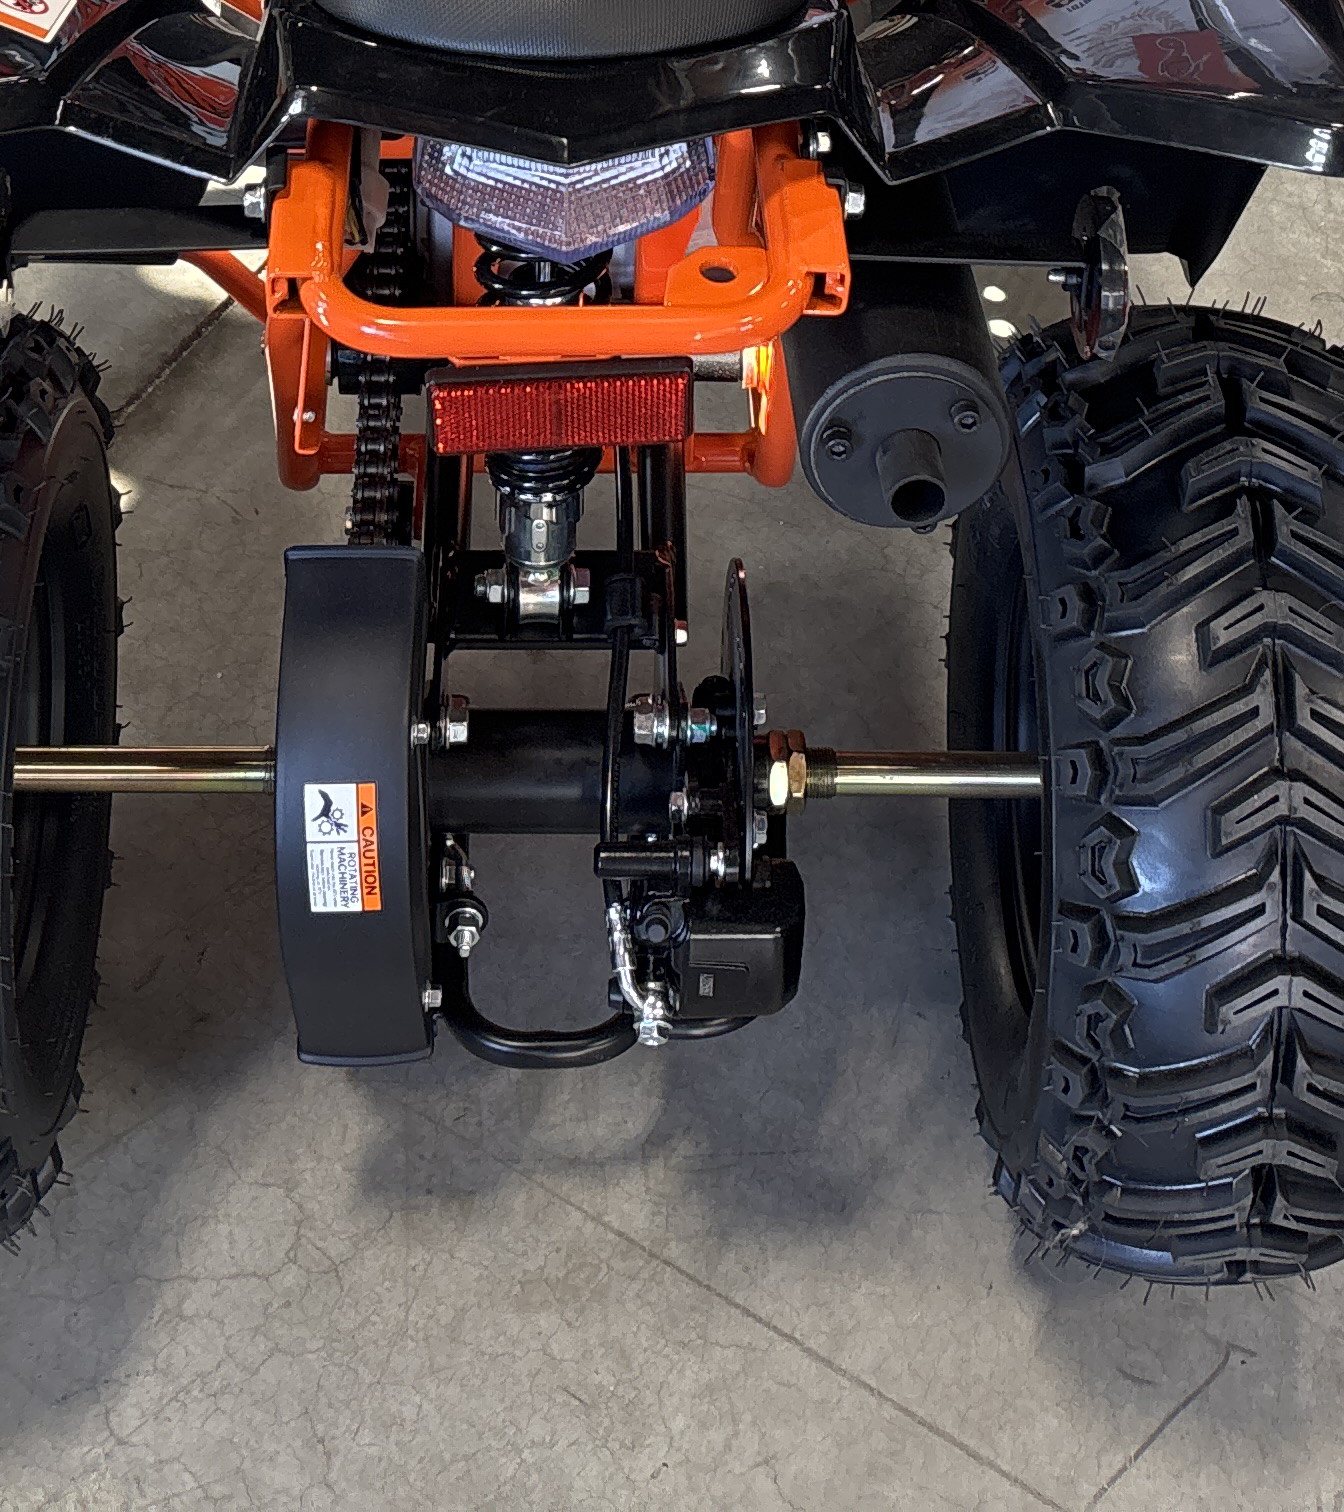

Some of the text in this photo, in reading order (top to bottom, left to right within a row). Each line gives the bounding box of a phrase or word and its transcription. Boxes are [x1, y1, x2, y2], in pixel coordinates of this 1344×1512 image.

[337, 846, 350, 908] MACHINERY
[347, 852, 360, 904] ROTATING
[361, 826, 378, 896] CAUTION
